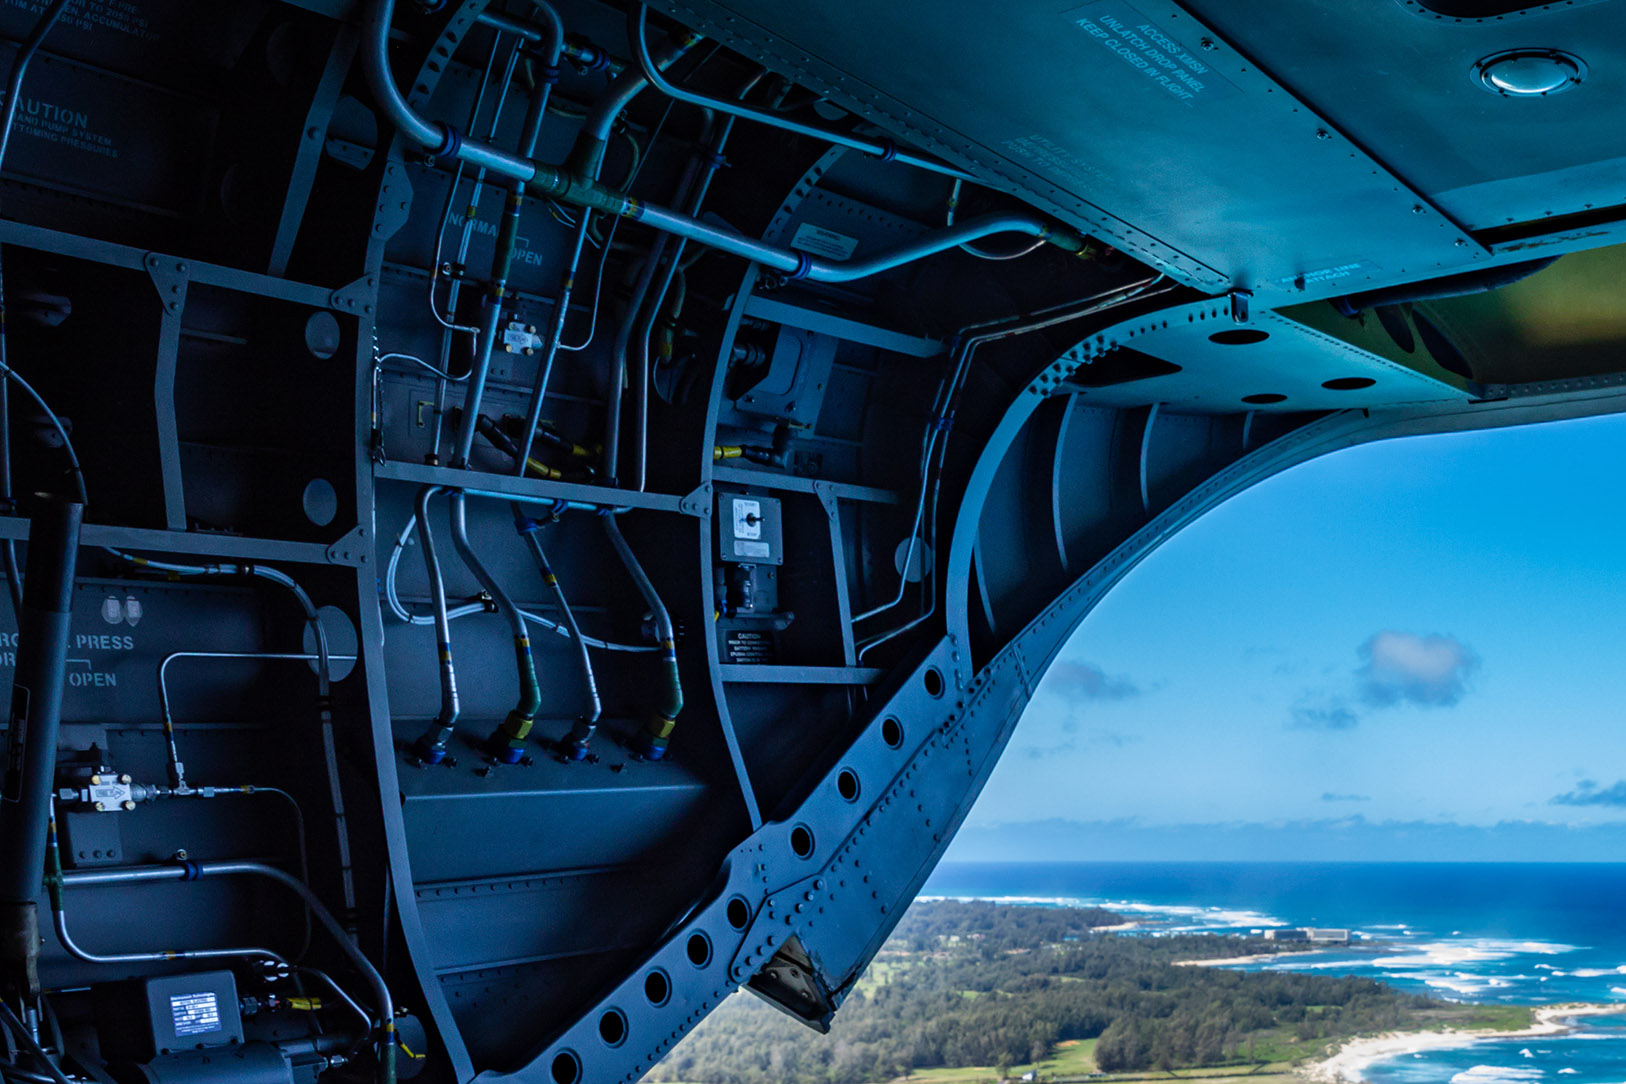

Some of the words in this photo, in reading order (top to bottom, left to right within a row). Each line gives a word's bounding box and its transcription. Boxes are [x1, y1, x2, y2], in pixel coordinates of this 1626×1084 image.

[1075, 17, 1110, 39] KEEP
[1104, 38, 1149, 69] CLOSED
[1144, 67, 1160, 77] IN
[1155, 75, 1194, 100] FLIGHT
[1099, 15, 1151, 50] UNLATCH
[1145, 48, 1177, 70] DROP
[1171, 68, 1206, 93] PANEL
[1136, 24, 1181, 54] ACCESS
[1175, 52, 1209, 75] XMSN
[448, 211, 498, 237] NORMA
[76, 634, 134, 650] PRESS
[69, 672, 117, 687] OPEN
